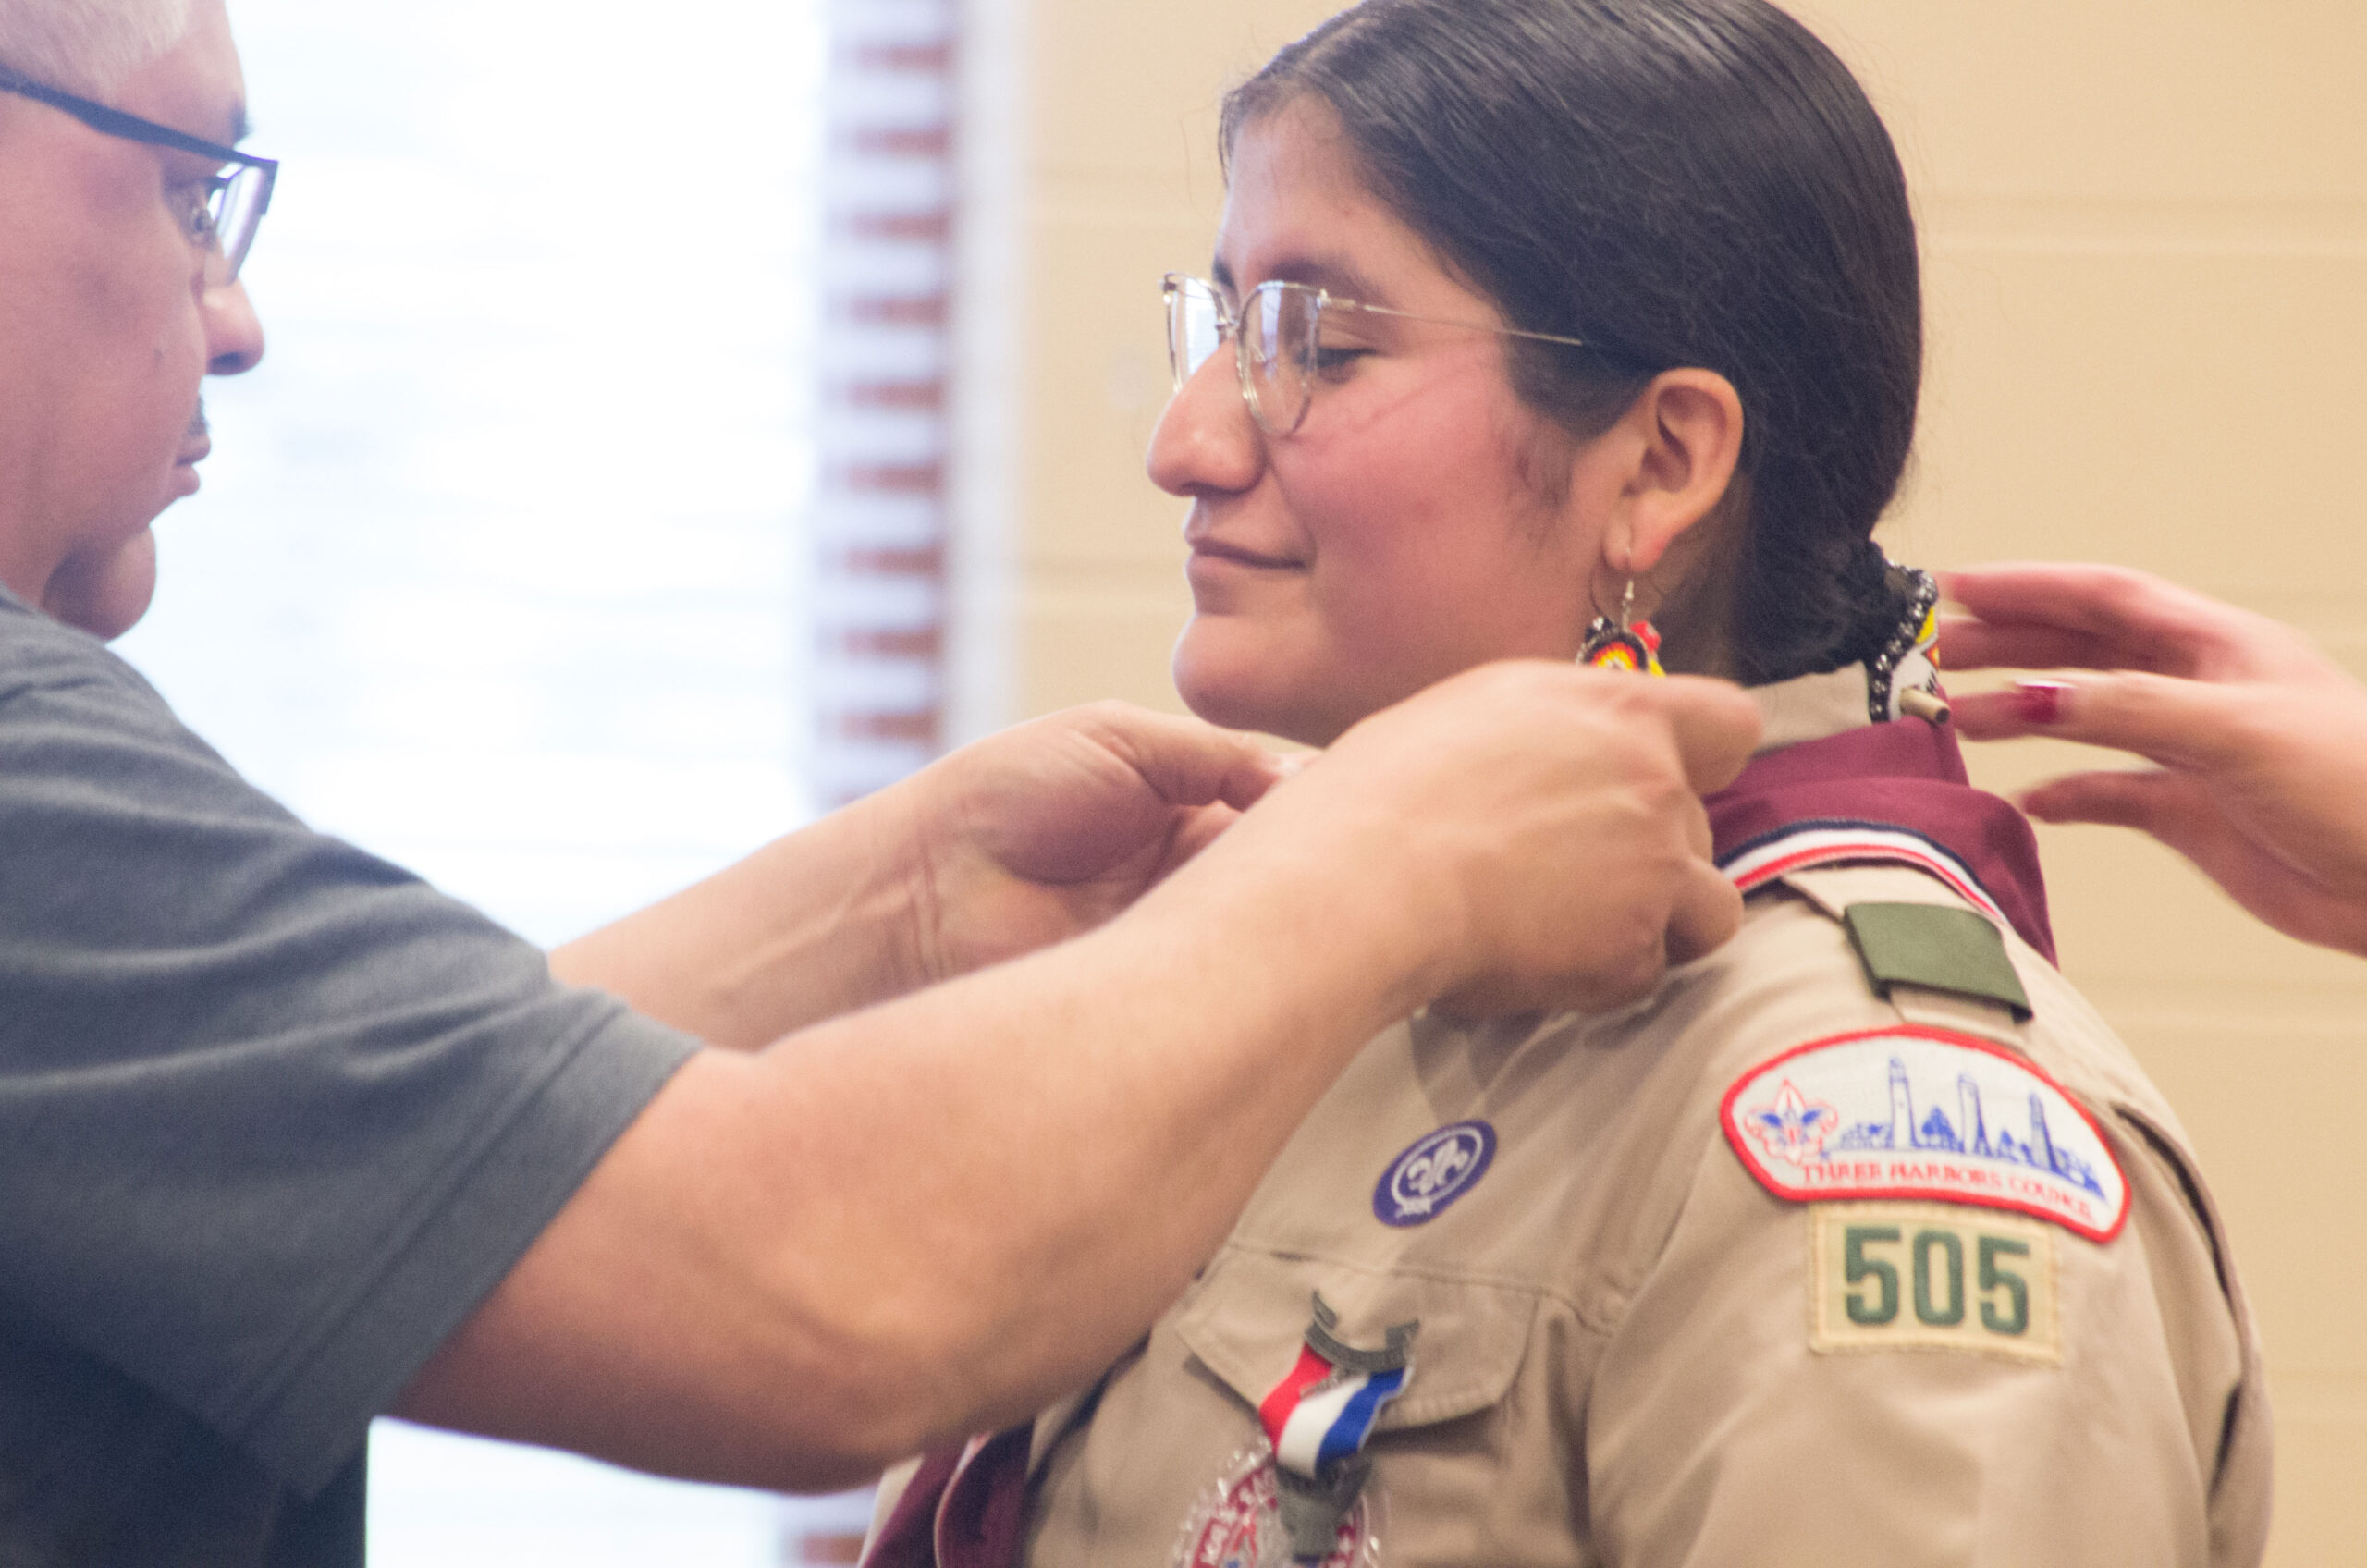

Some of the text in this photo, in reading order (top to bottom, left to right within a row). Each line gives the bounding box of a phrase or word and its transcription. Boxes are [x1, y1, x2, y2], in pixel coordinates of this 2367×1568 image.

[1803, 1161, 2093, 1222] THREE HARBORS COUNCIL
[1845, 1226, 2030, 1336] 505
